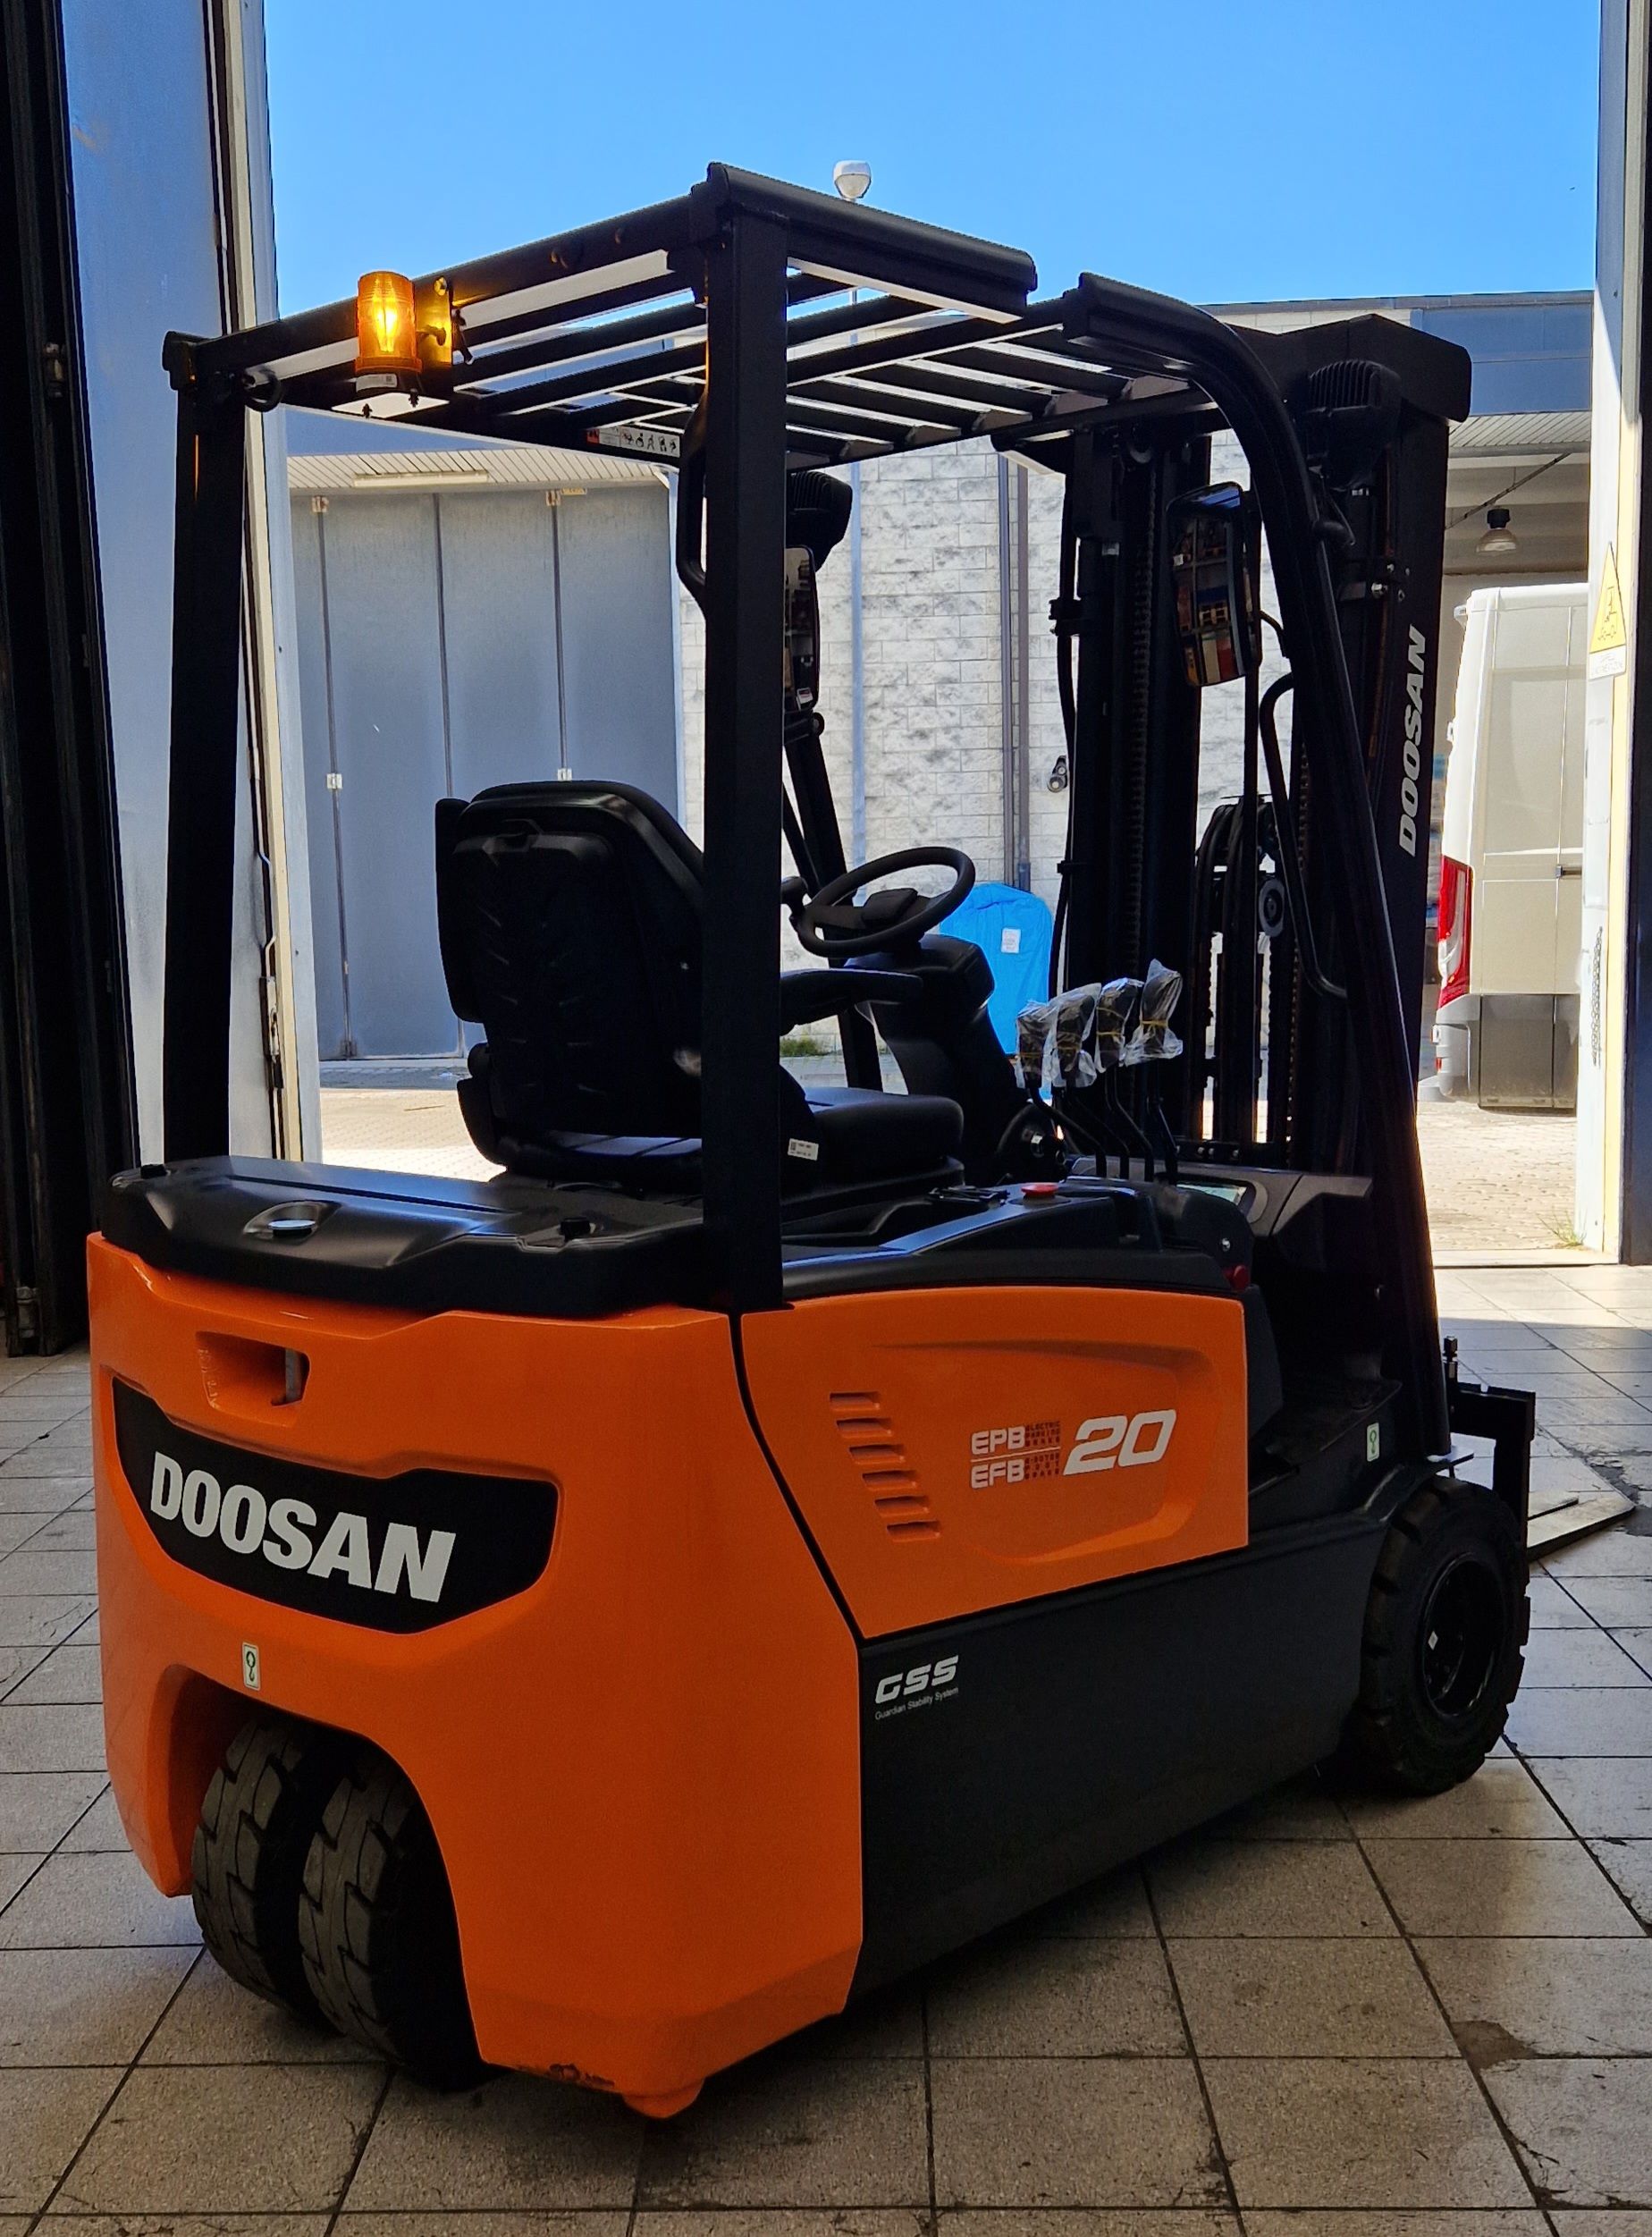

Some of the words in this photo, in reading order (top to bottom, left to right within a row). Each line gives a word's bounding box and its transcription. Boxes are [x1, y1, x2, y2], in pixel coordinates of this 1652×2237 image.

[1399, 623, 1426, 857] DOOSAN
[971, 1426, 1025, 1455] EPB
[1063, 1409, 1177, 1475] 20
[971, 1458, 1025, 1489] EFB
[150, 1451, 457, 1602] DOOSAN
[875, 1704, 906, 1720] Guardian
[907, 1696, 933, 1709] Stability
